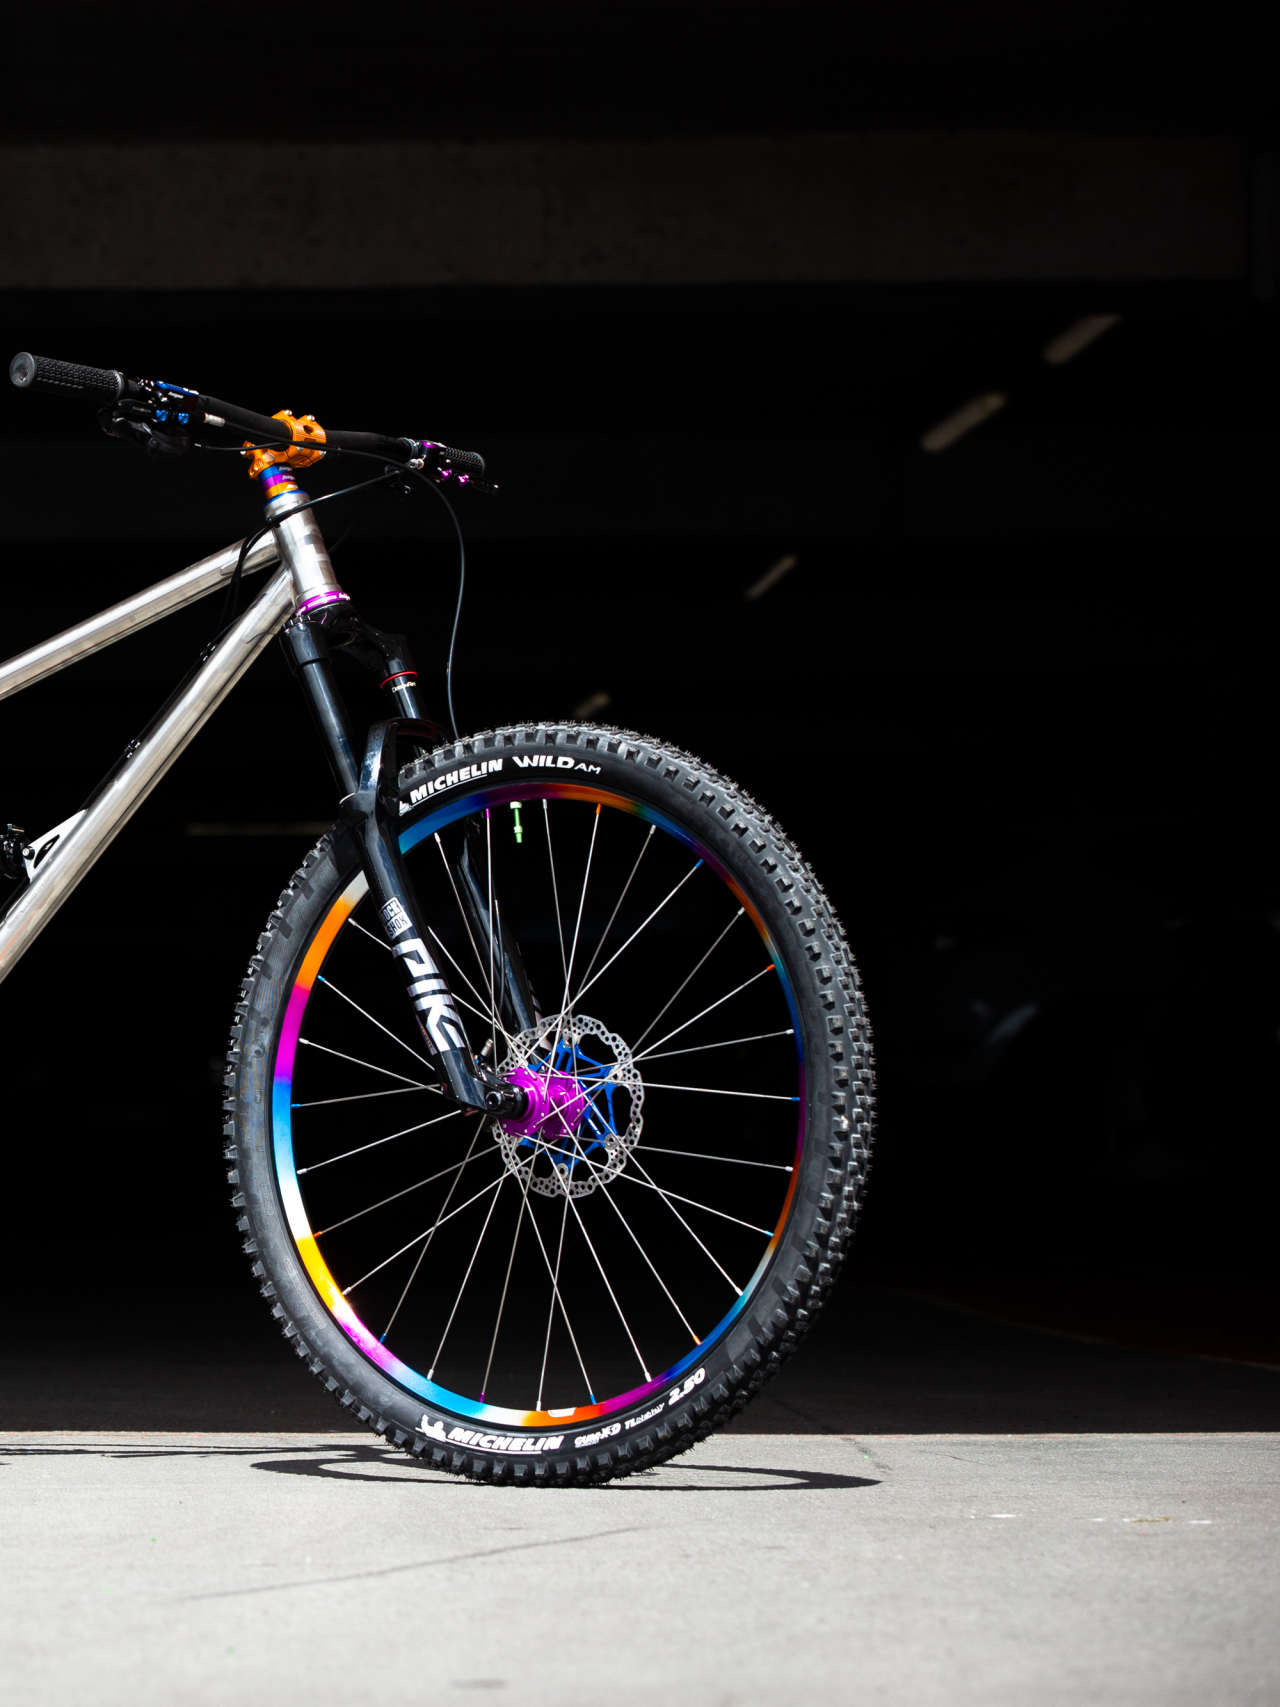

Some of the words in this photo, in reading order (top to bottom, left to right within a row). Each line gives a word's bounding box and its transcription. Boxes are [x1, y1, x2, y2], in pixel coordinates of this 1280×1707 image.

[409, 758, 503, 804] MICHELIN
[512, 754, 575, 769] WILD
[574, 762, 602, 775] AM
[386, 914, 408, 937] SHOX
[391, 938, 466, 1053] PIKE
[447, 1427, 564, 1451] MICHELIN
[668, 1367, 706, 1405] 2.50
